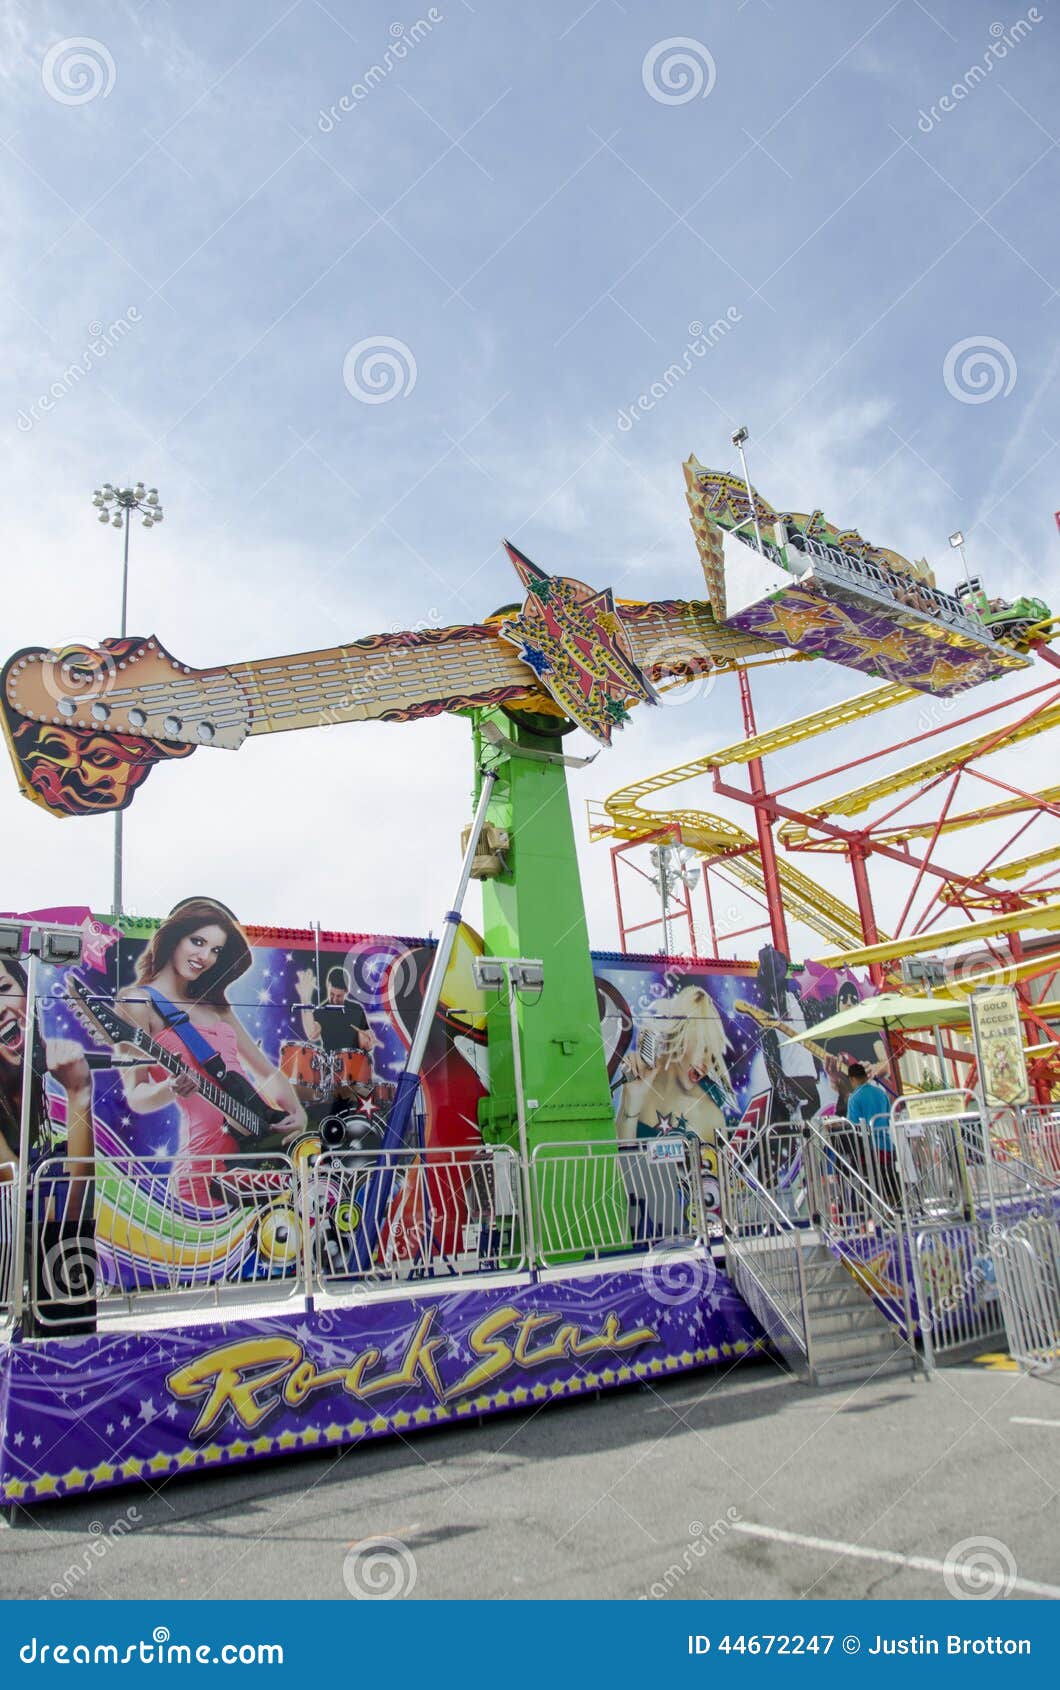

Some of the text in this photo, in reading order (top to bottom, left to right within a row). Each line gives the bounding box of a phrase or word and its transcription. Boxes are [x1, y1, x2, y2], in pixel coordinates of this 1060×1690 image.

[983, 1001, 1008, 1012] GOLD
[656, 1143, 682, 1157] EXIT
[165, 1305, 661, 1440] Rock Star
